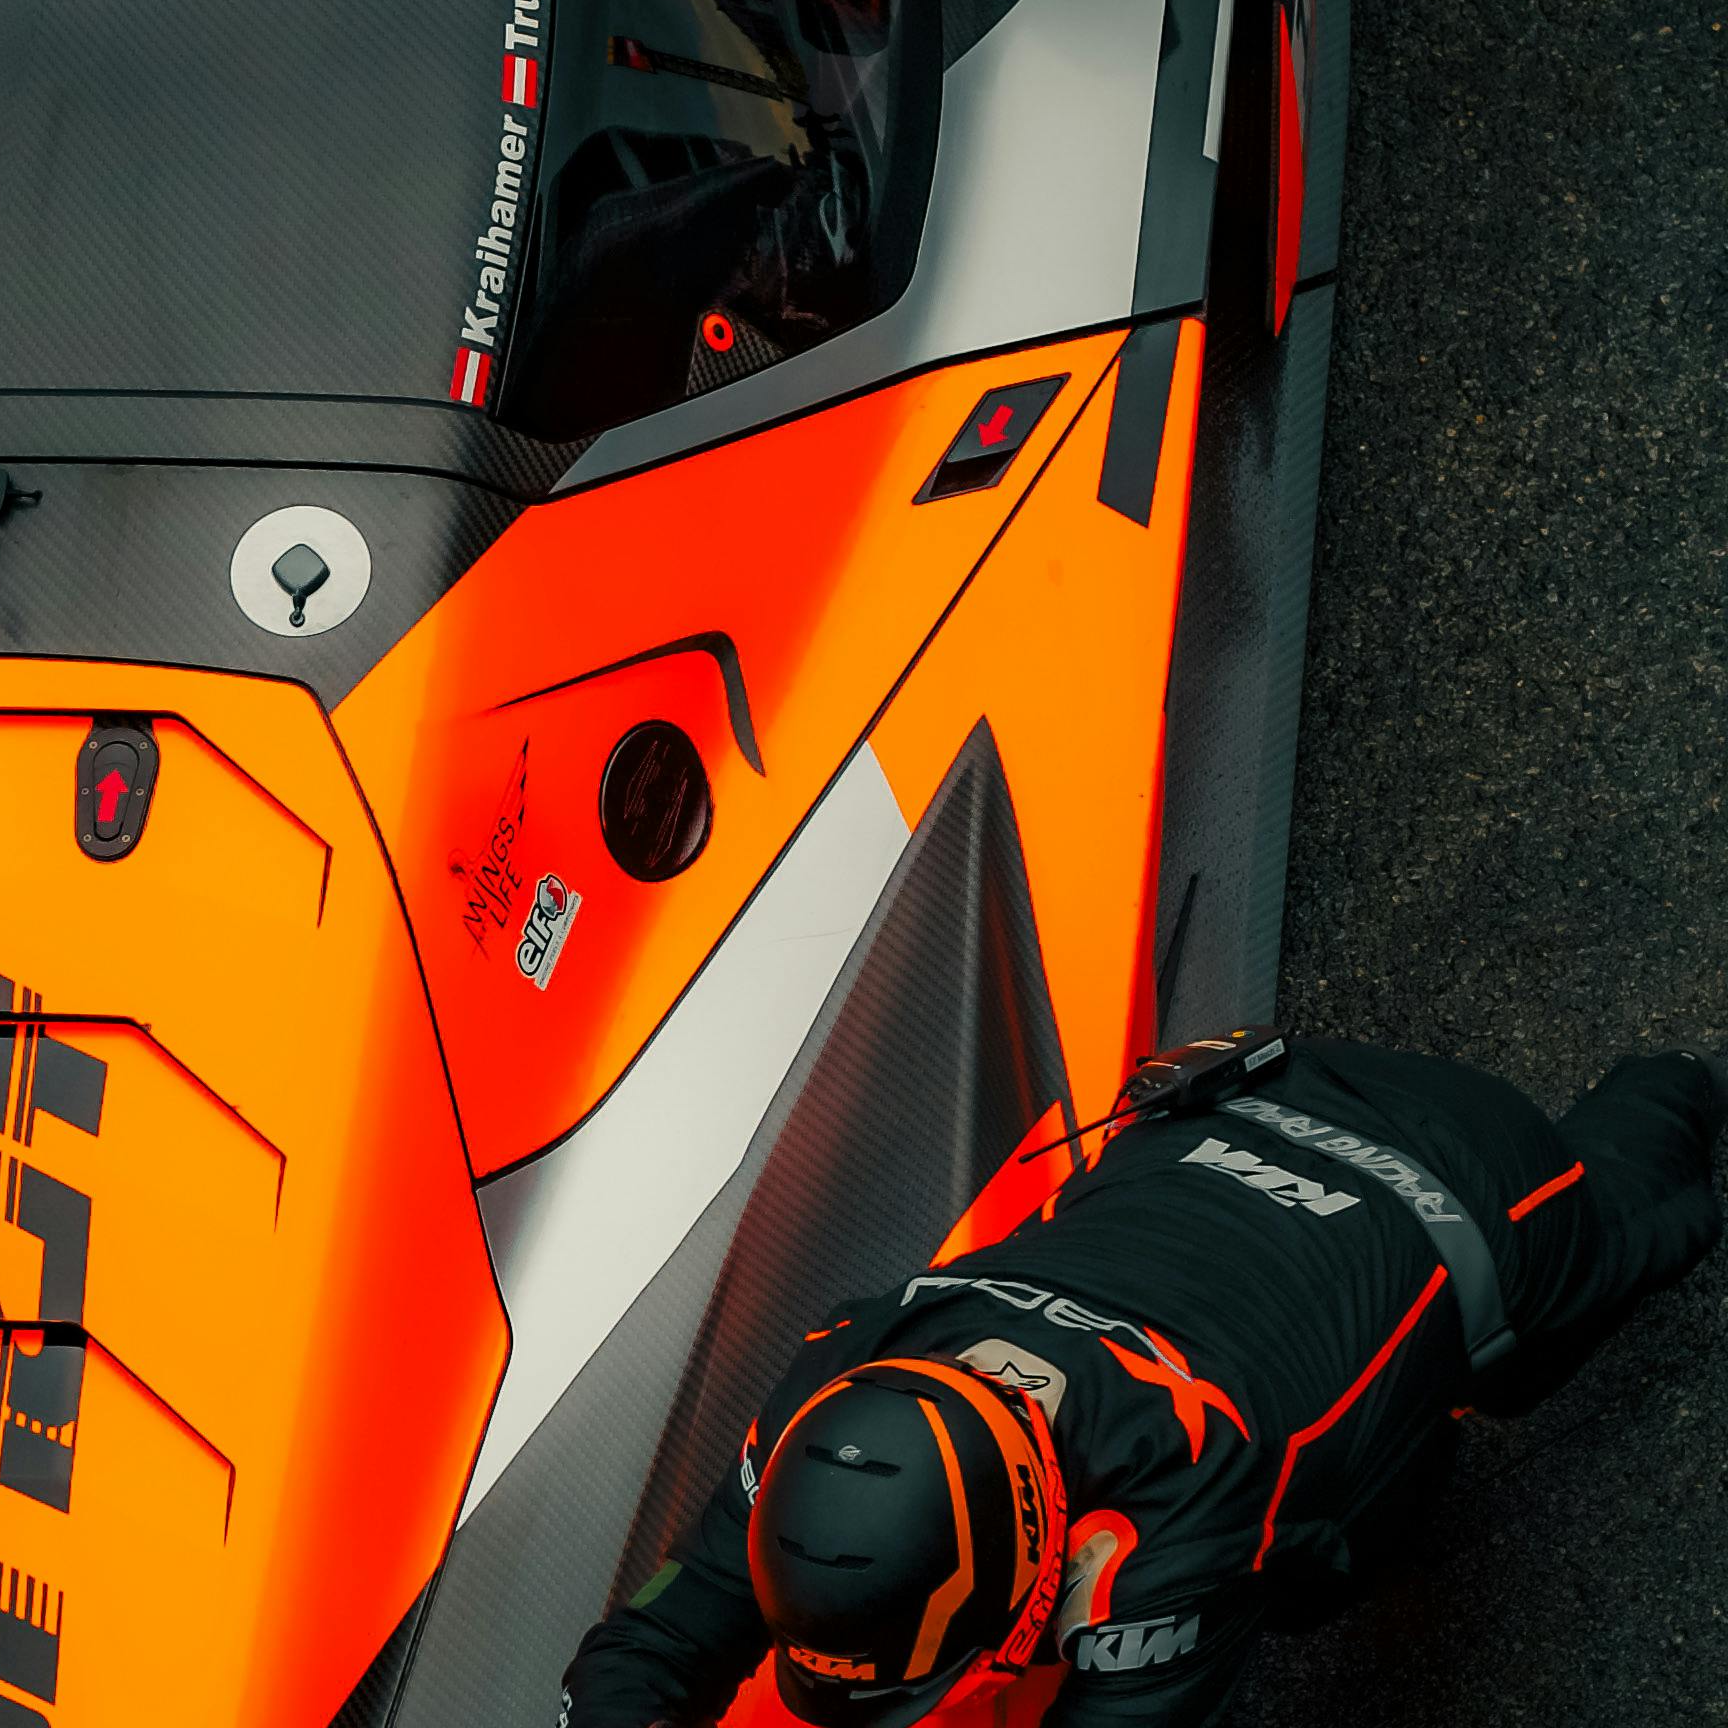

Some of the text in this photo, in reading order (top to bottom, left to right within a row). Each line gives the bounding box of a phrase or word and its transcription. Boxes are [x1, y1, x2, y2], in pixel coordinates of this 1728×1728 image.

[460, 113, 529, 348] Kraihamer
[1178, 1136, 1361, 1218] KTM
[787, 1645, 876, 1681] KTM
[1075, 1610, 1200, 1673] KTM
